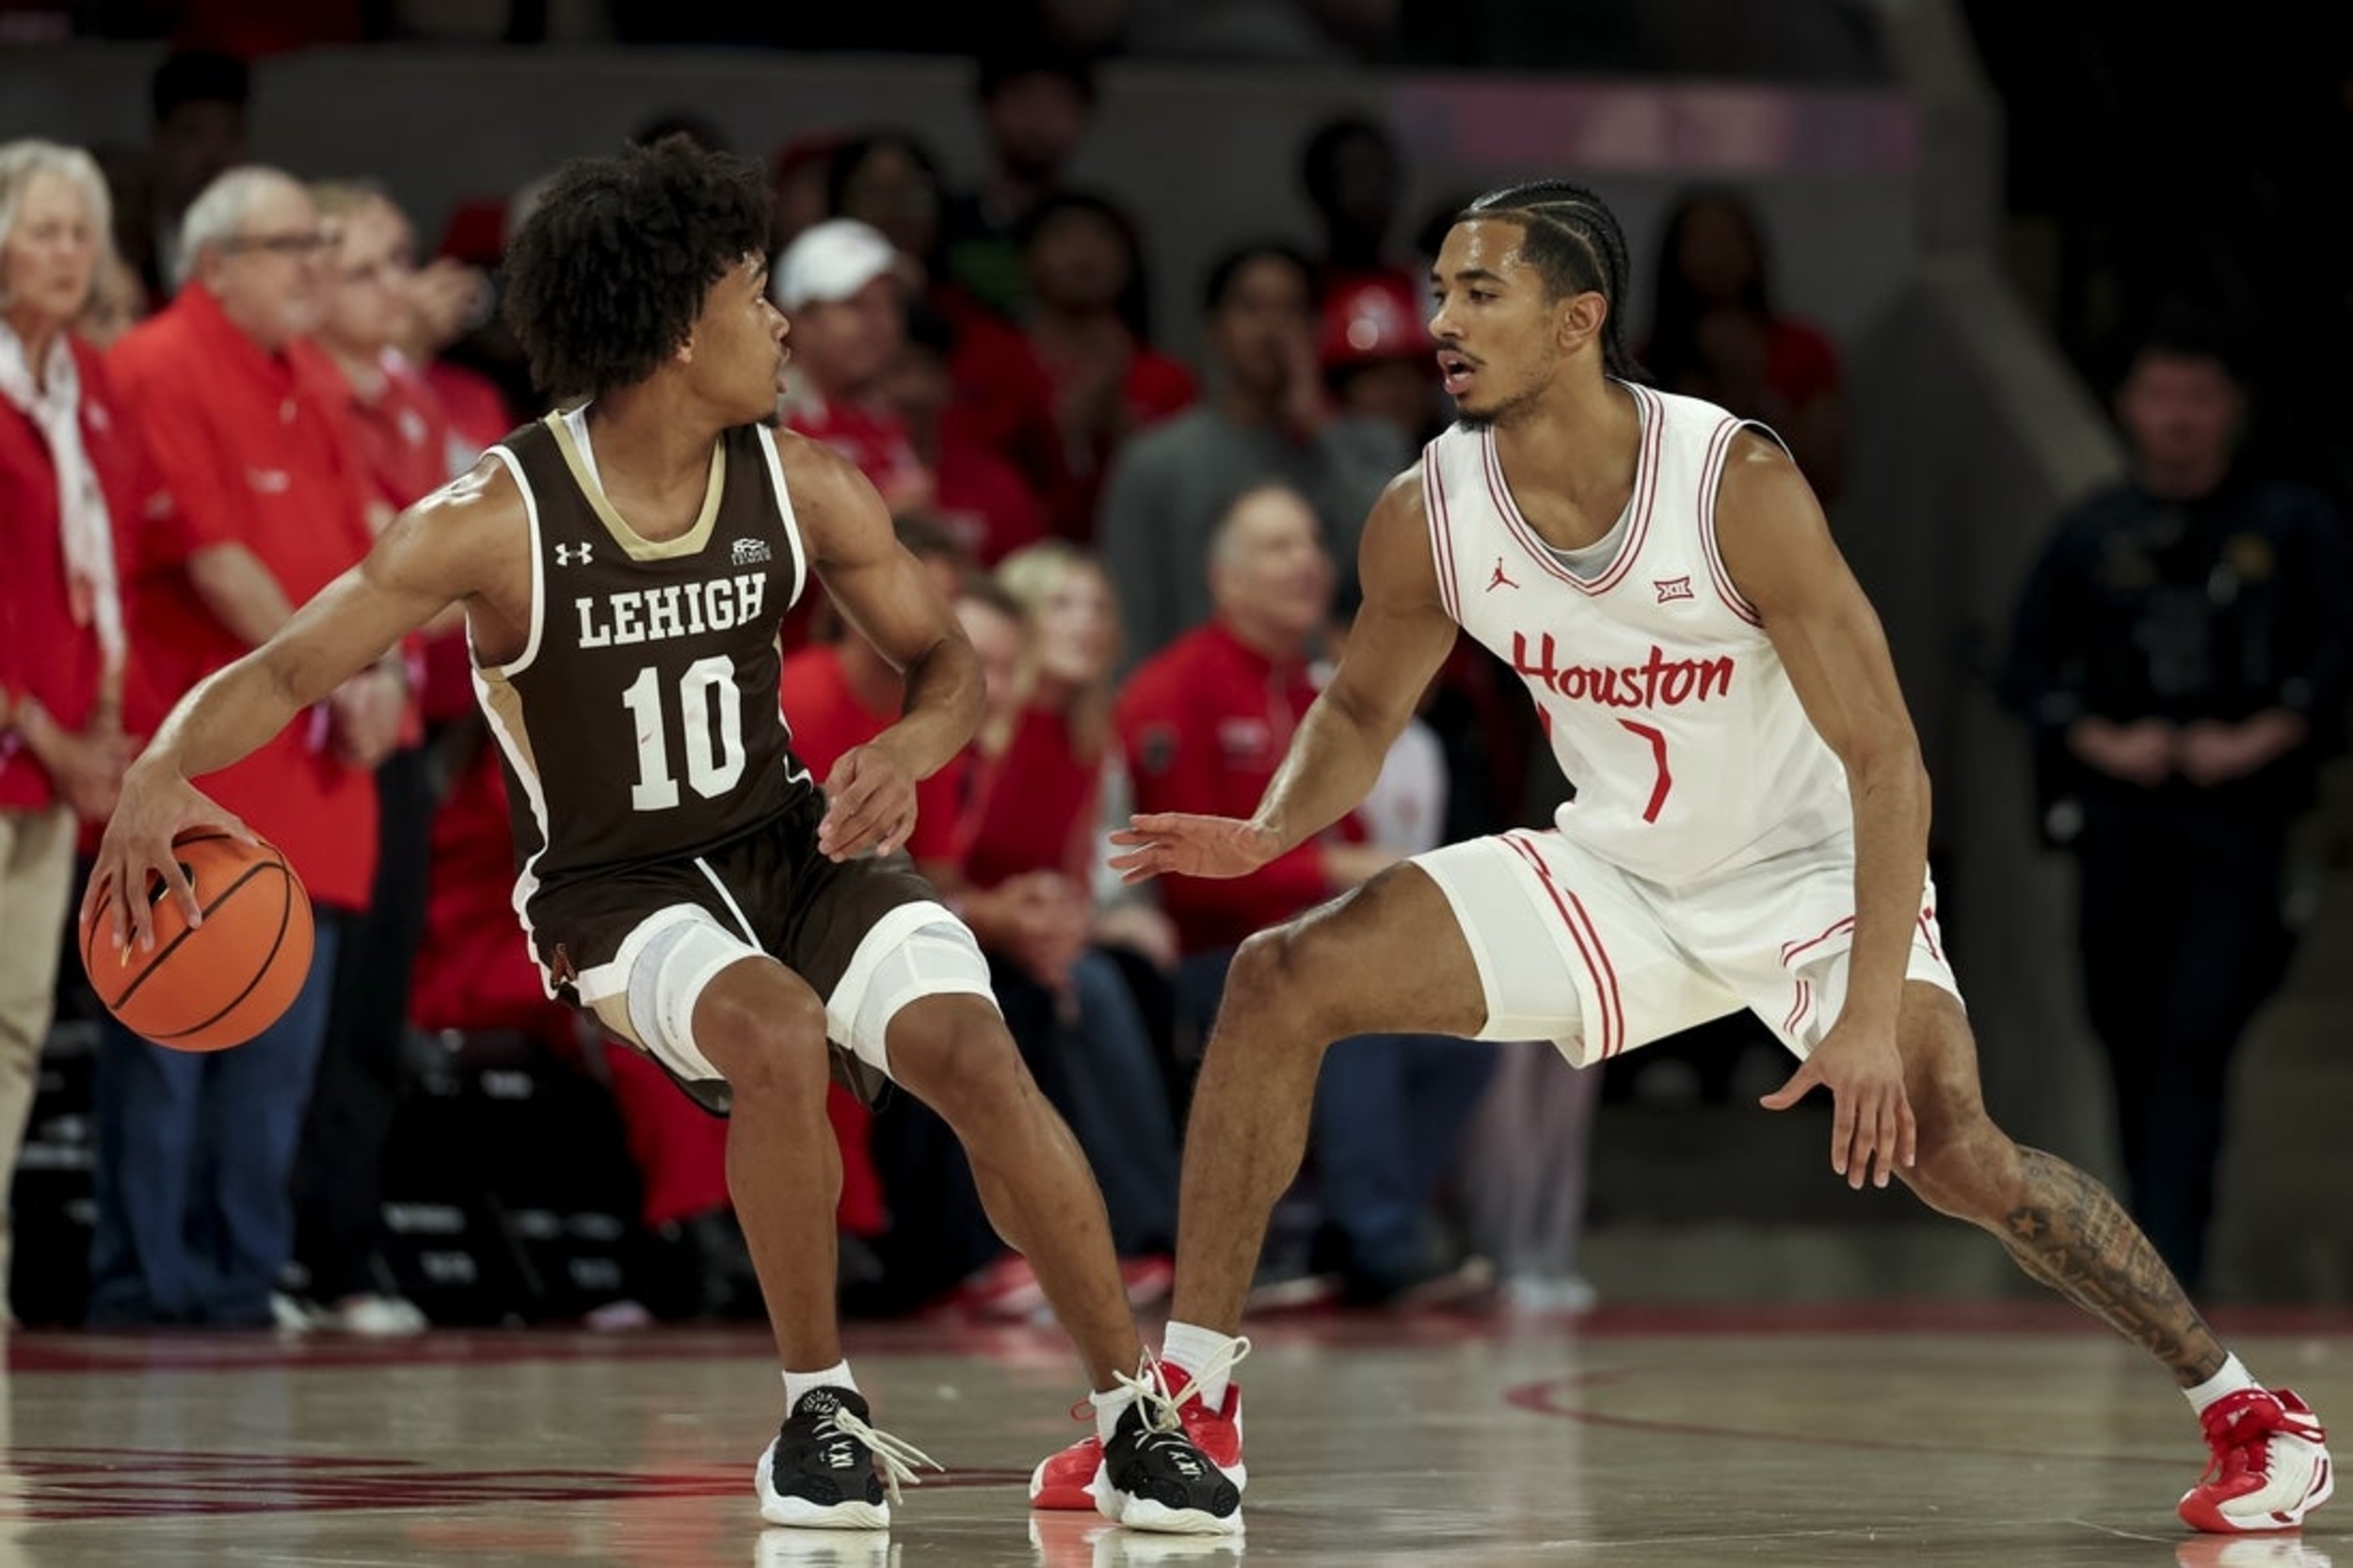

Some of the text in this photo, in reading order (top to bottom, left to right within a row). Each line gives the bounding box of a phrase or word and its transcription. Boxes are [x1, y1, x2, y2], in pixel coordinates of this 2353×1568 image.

[576, 572, 767, 648] LEHIGH
[1513, 631, 1734, 710] Houston
[622, 654, 746, 812] 10
